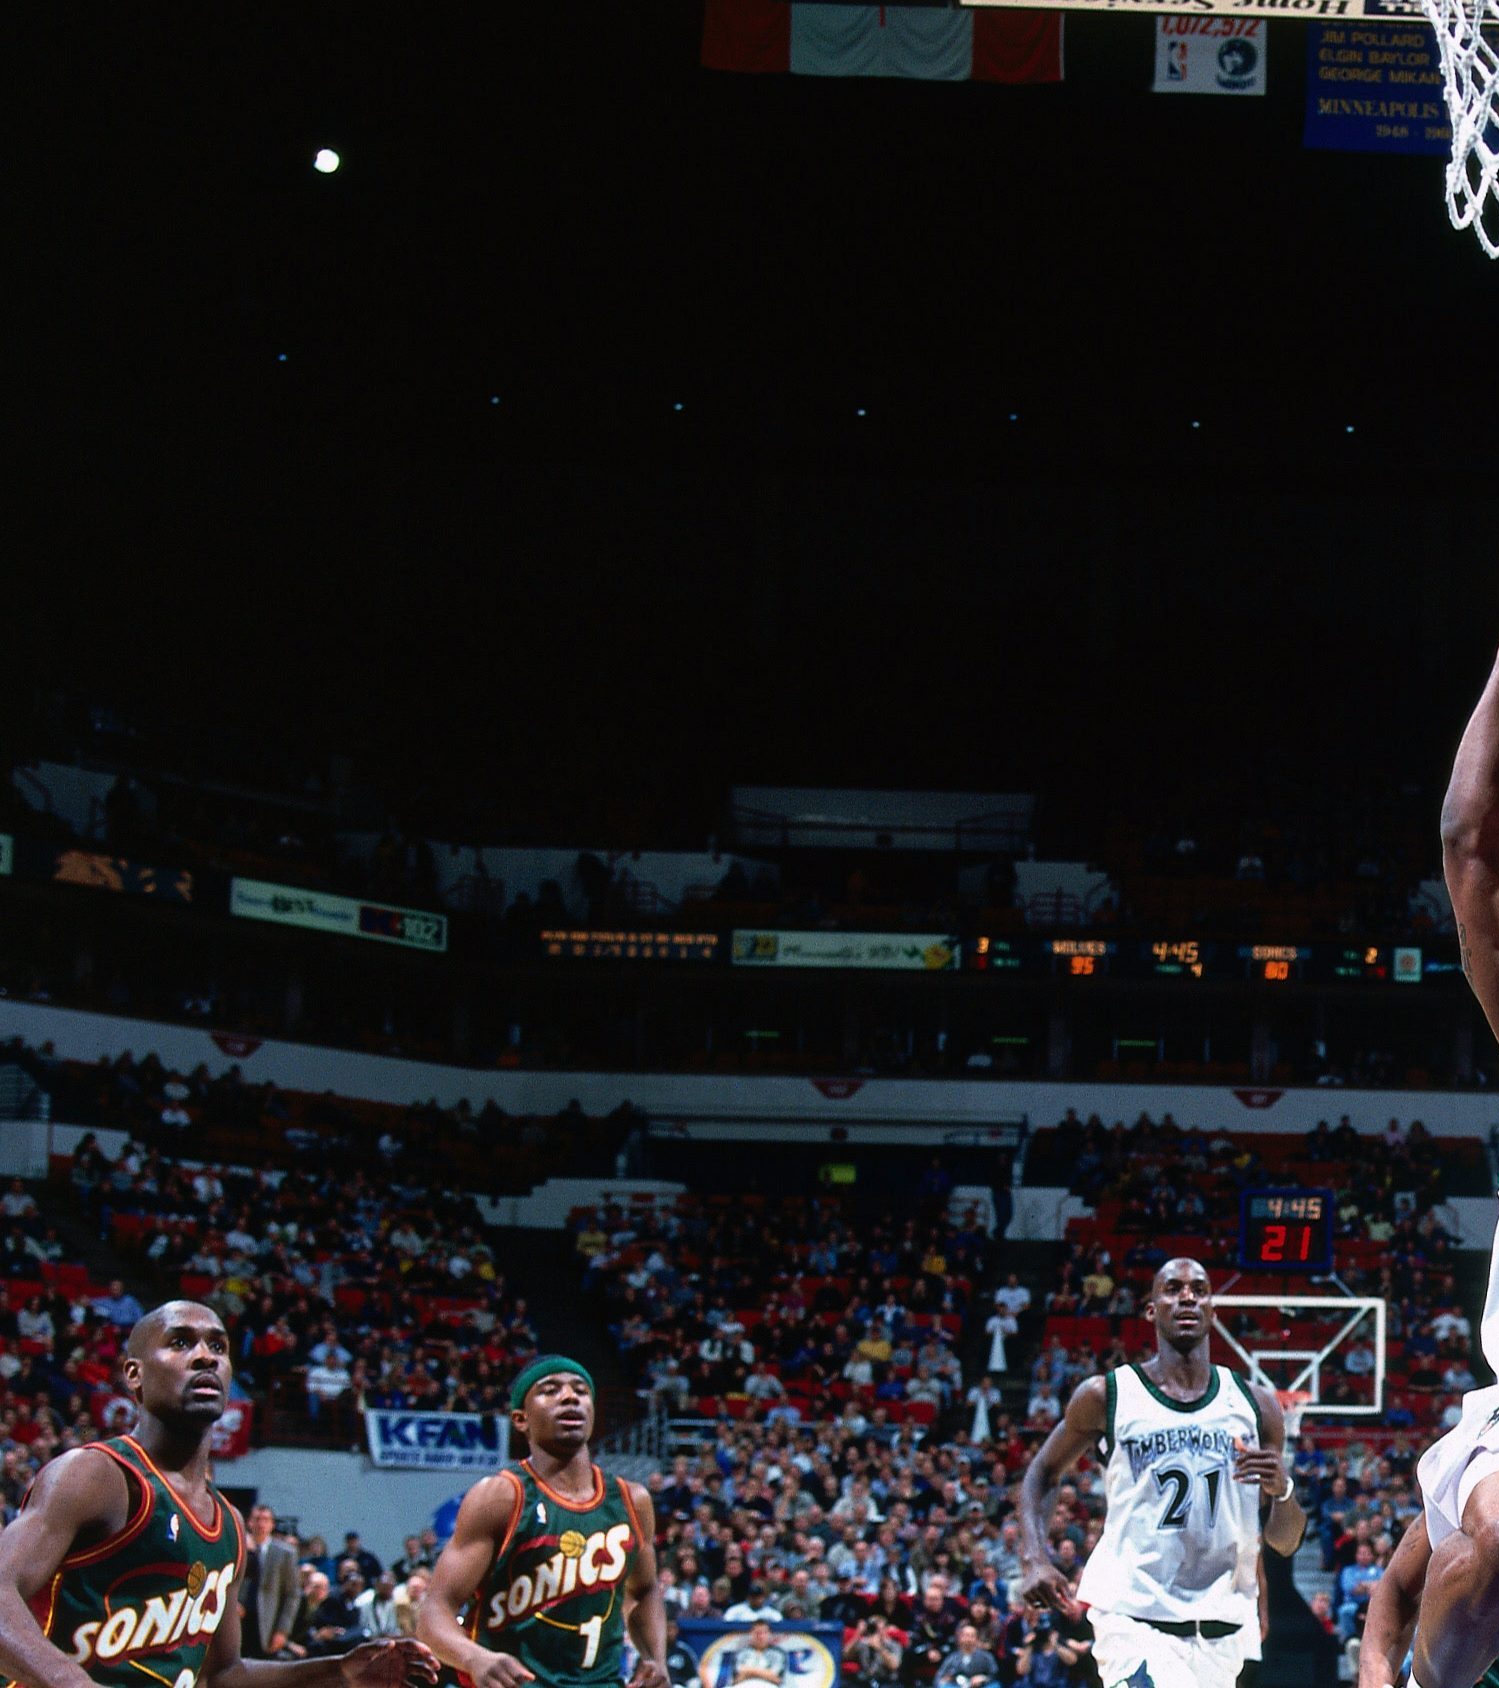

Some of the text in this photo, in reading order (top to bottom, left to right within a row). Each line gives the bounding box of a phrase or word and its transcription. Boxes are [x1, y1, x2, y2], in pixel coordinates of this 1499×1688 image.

[1319, 48, 1430, 65] ELGIN BAYLOR
[1321, 30, 1425, 48] JIM POLLARD
[1319, 66, 1382, 83] GEORGE
[1319, 98, 1440, 119] MINNEAPOLIS
[1152, 940, 1199, 963] 4:45
[1267, 1197, 1322, 1220] 4:45
[1261, 1225, 1311, 1261] 21
[379, 1416, 499, 1451] KFAN
[1120, 1424, 1255, 1482] TIMBERWOLV
[1151, 1463, 1226, 1530] 21
[487, 1523, 631, 1629] SONICS
[70, 1562, 236, 1664] SONICS
[579, 1615, 602, 1668] 1
